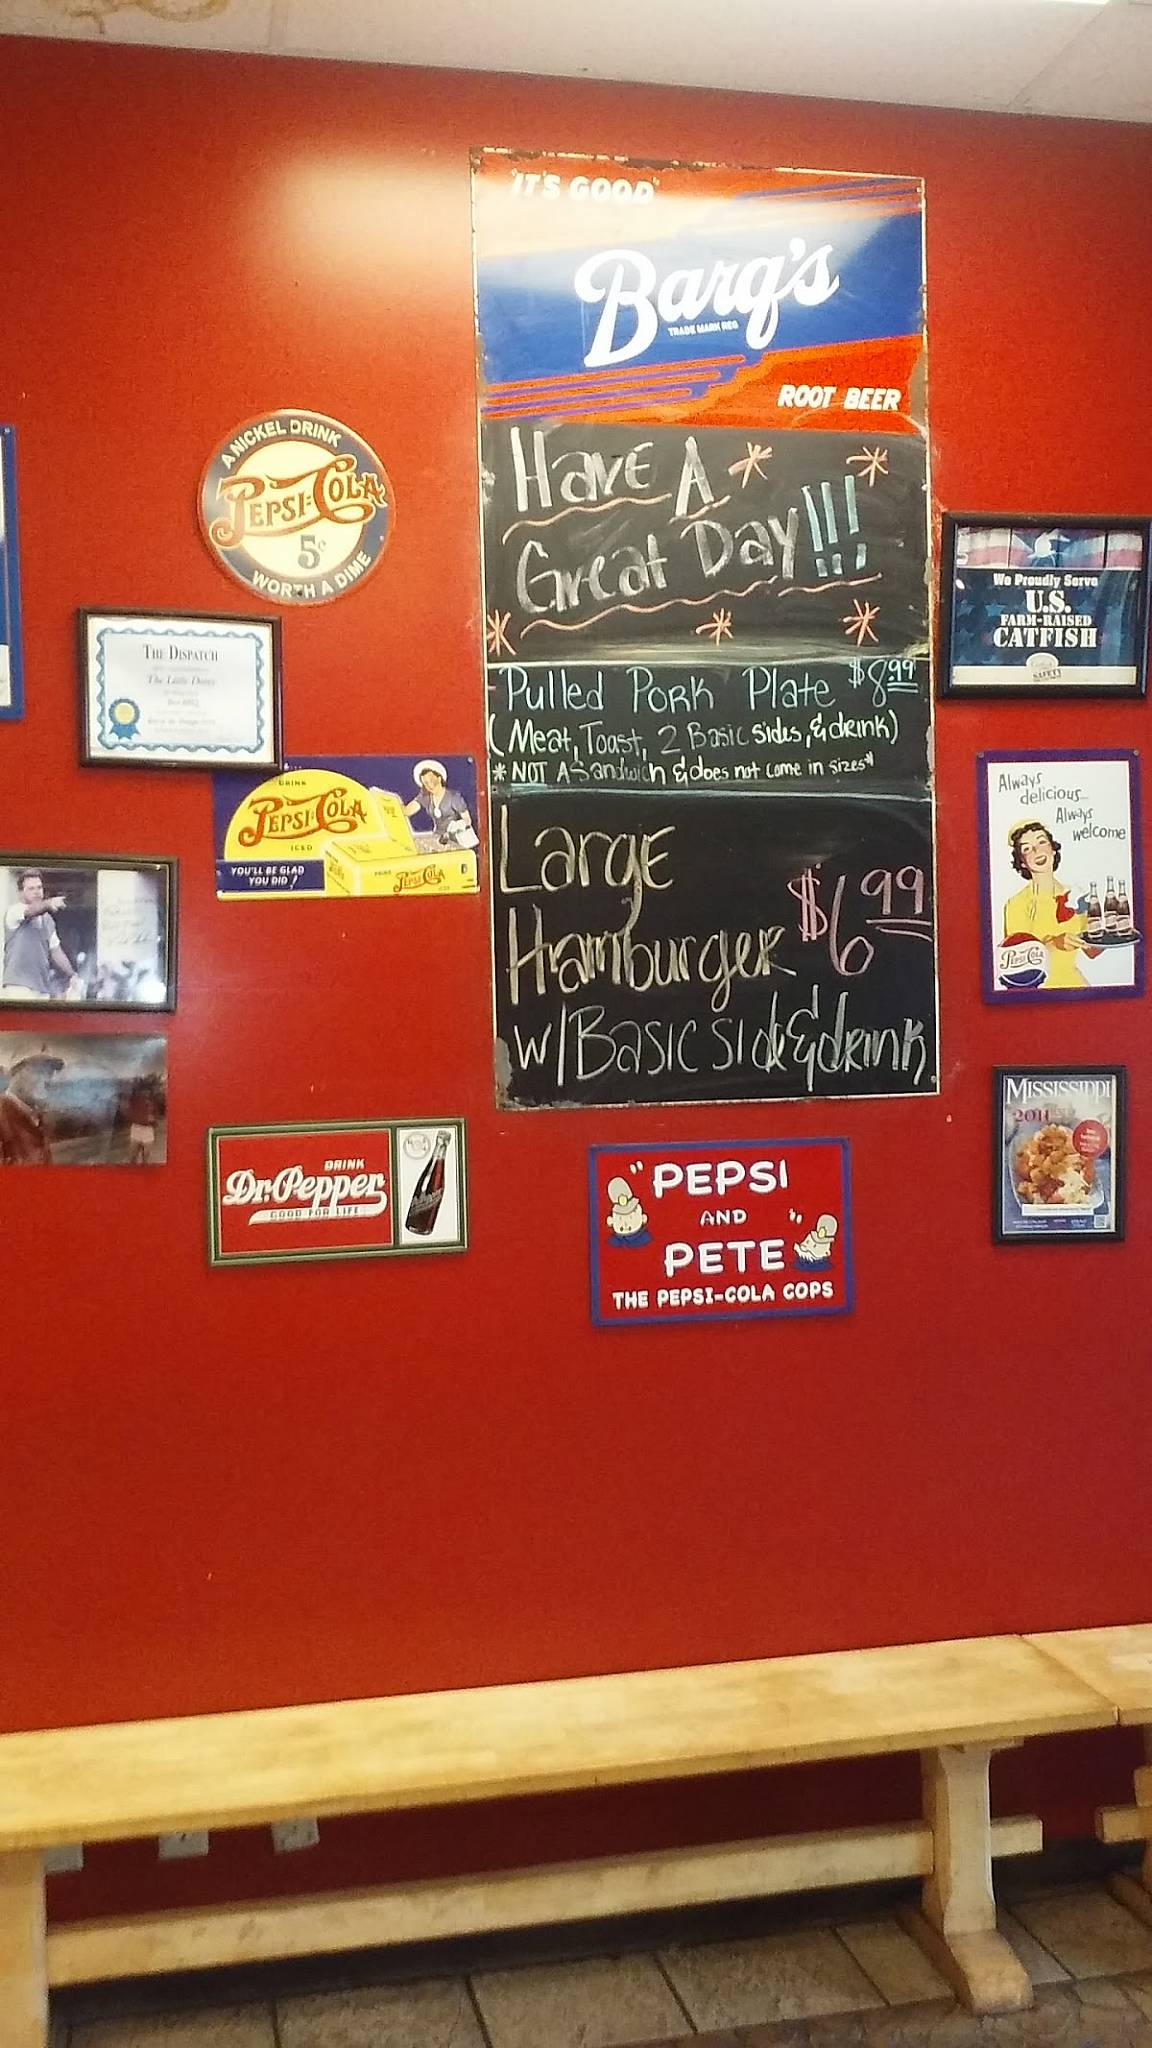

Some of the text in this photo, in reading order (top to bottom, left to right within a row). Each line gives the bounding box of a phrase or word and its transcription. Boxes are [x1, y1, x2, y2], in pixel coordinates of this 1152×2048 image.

[574, 238, 839, 367] Barq's
[776, 384, 901, 412] ROOT BEER
[222, 419, 342, 469] A NICKEL DRINK
[675, 435, 714, 519] A
[252, 550, 371, 598] WORTH A DIME
[517, 534, 668, 614] Great
[993, 572, 1099, 588] We Proudly Serve
[1025, 590, 1072, 613] U.S.
[1000, 614, 1092, 627] FARM-RAISED
[993, 627, 1098, 648] CATFISH
[169, 644, 218, 662] DISPATCH
[499, 663, 605, 712] Pulled
[626, 666, 715, 714] Pork
[742, 665, 836, 710] Plate
[657, 725, 682, 755] 2
[686, 721, 749, 748] Basic
[571, 757, 667, 785] Sandwich
[689, 755, 729, 781] does
[734, 762, 760, 780] not
[765, 762, 802, 779] come
[807, 759, 824, 776] in
[998, 771, 1042, 793] Always
[1055, 807, 1093, 824] Always
[1072, 823, 1127, 841] welcome
[248, 876, 267, 887] YOU
[262, 867, 279, 876] BE
[279, 866, 305, 876] GLAD
[506, 904, 797, 1013] Hamburger
[324, 1158, 365, 1171] DRINK
[270, 1206, 360, 1221] GOOD FOR LIFE
[700, 1208, 747, 1226] AND
[612, 1280, 834, 1310] THE PEPSI-COLA COPS
